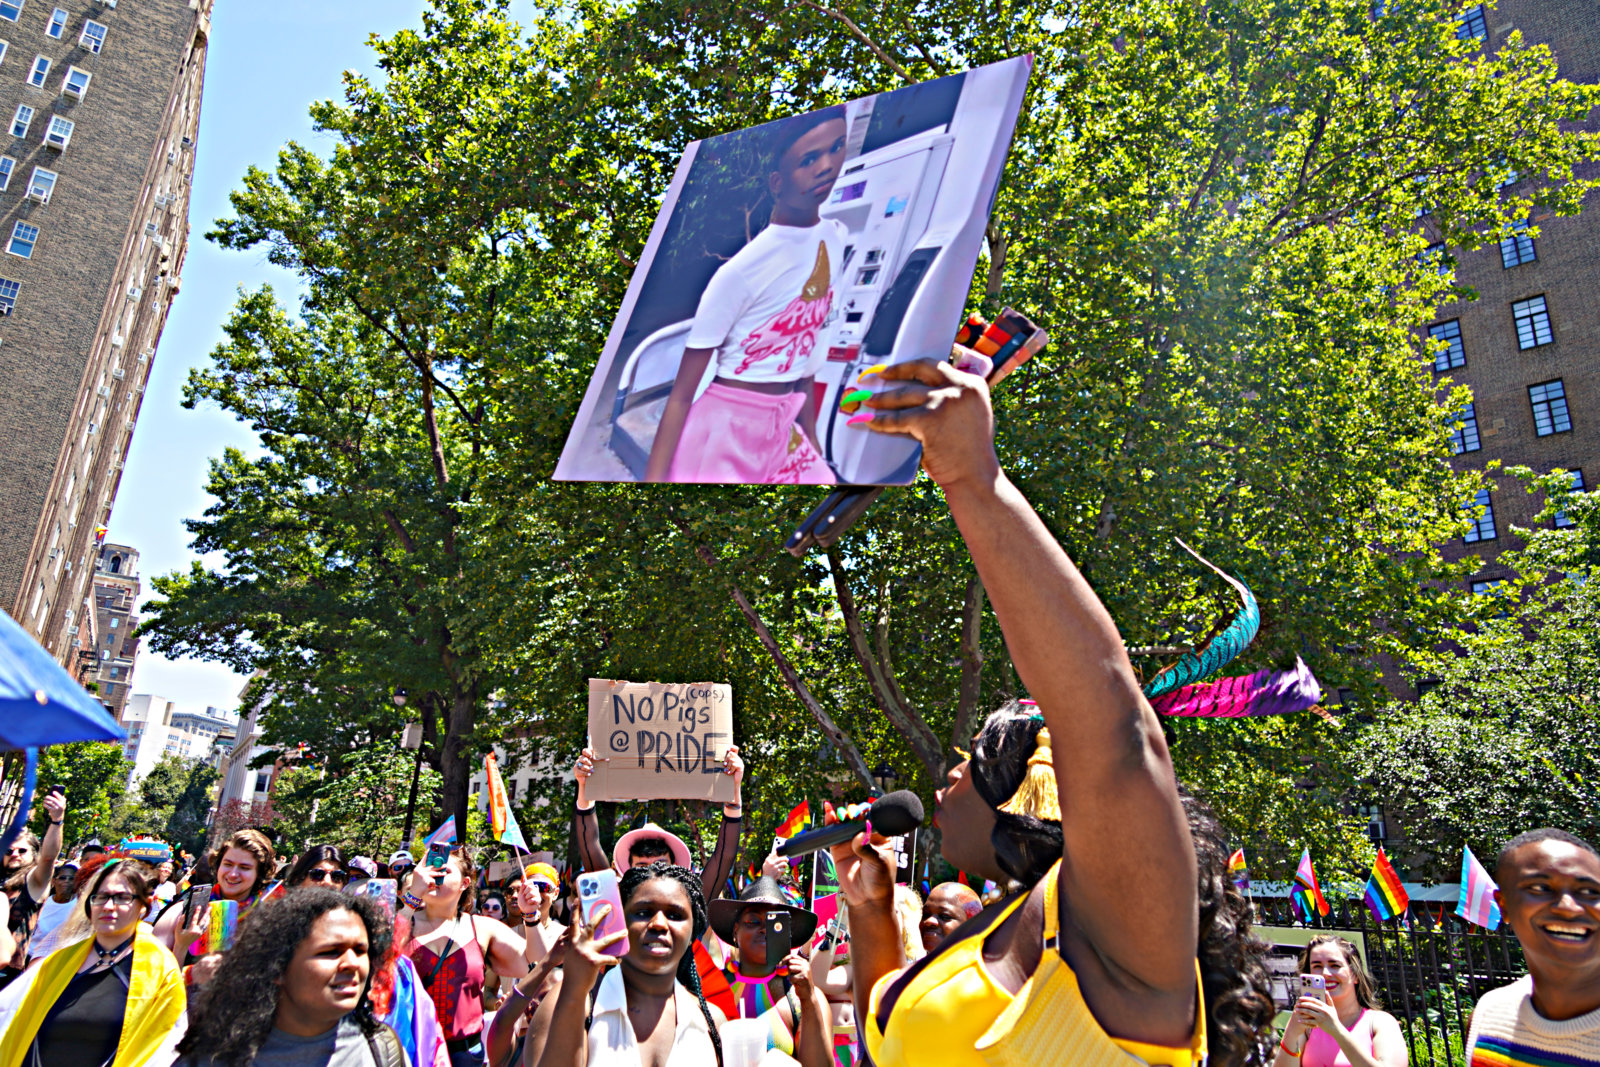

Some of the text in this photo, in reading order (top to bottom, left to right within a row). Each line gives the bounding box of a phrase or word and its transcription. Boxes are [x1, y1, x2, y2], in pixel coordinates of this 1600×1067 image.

[612, 691, 711, 734] NO Pigs
[609, 730, 728, 775] @ PRIDE
